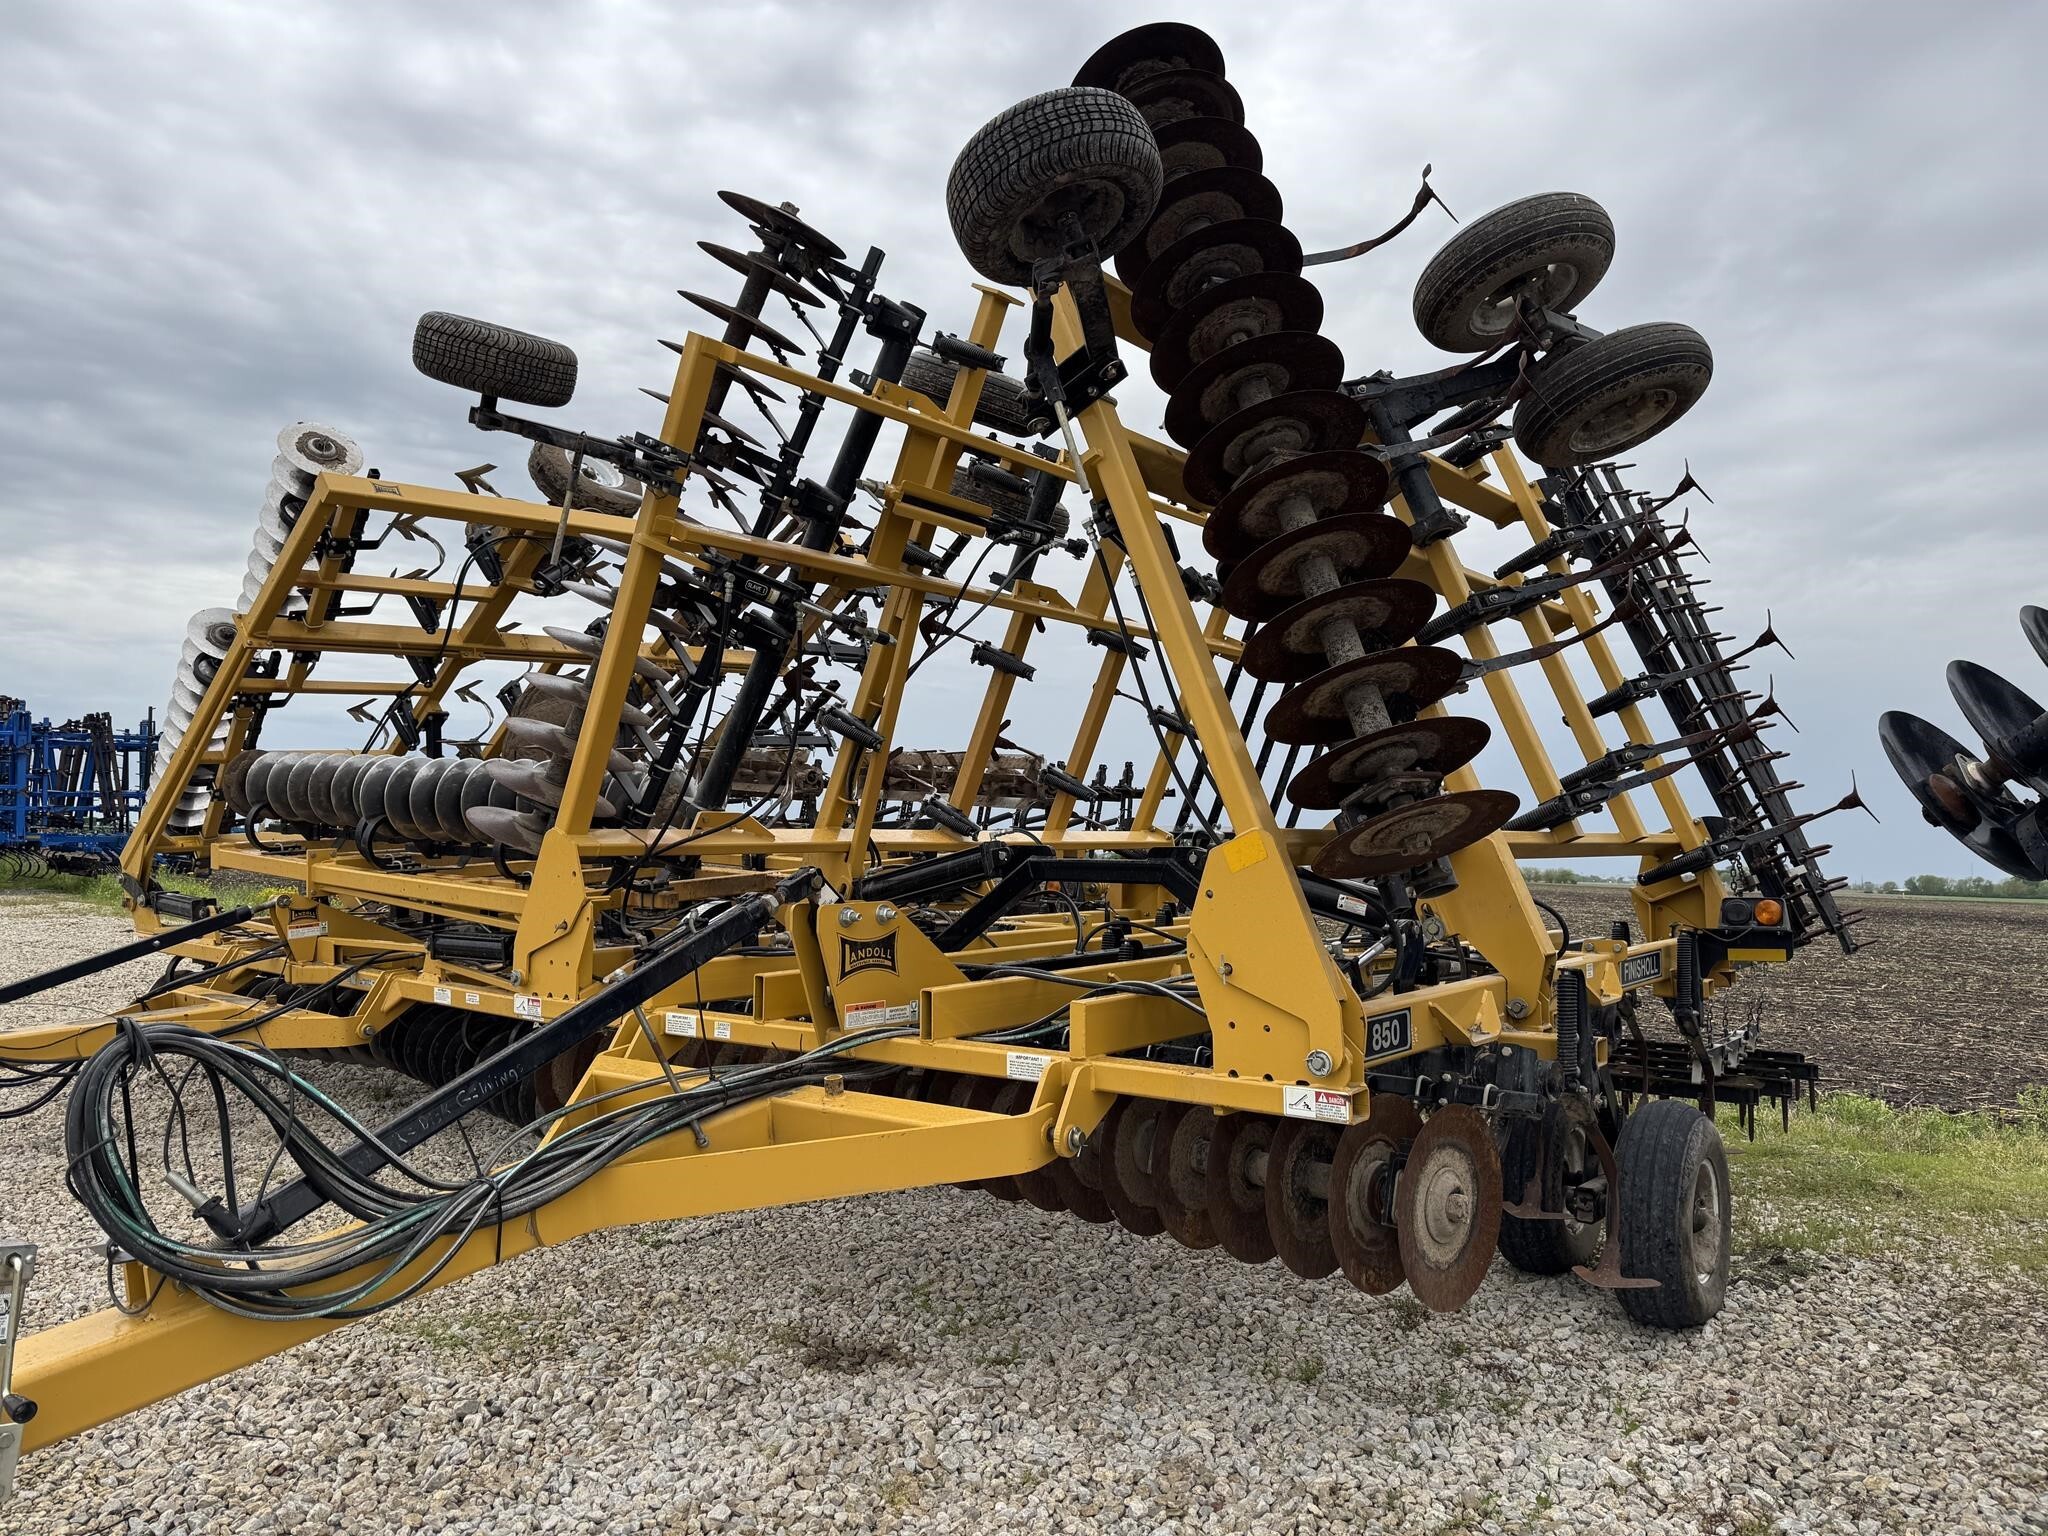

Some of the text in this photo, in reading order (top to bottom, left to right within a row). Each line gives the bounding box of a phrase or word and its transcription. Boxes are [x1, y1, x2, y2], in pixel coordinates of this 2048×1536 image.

[845, 943, 892, 973] LANDOLL
[1624, 956, 1659, 982] FINISHOLL
[1372, 1019, 1400, 1051] 850
